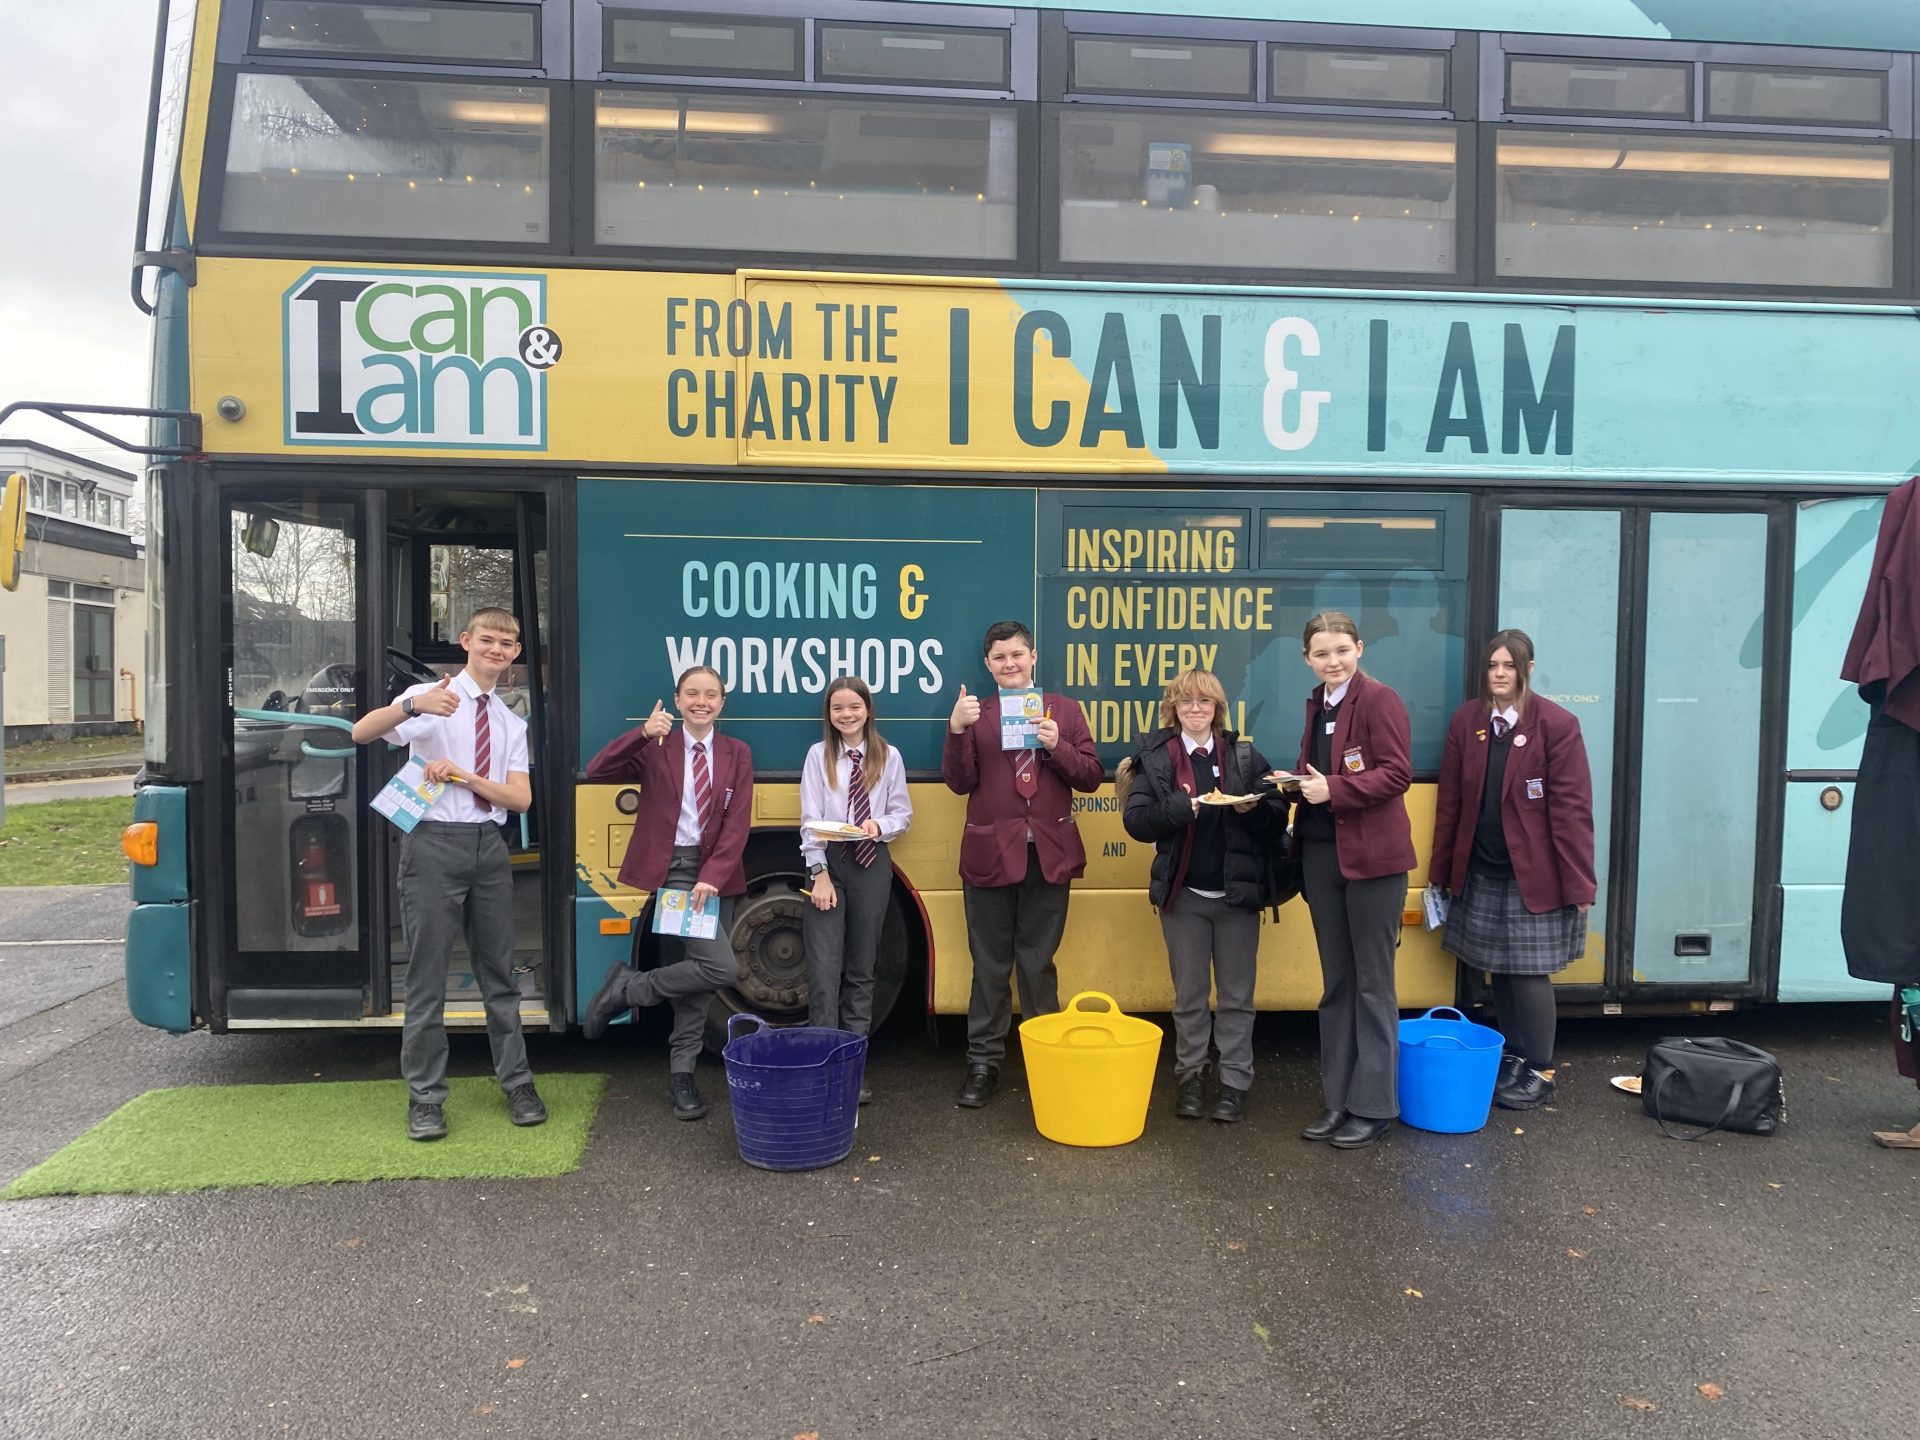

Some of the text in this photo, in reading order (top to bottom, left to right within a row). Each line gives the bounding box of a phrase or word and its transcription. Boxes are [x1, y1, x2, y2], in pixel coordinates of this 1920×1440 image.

[295, 279, 378, 434] I
[355, 282, 533, 366] can
[667, 297, 898, 364] FROM THE
[355, 352, 534, 436] am
[667, 368, 898, 444] CHARITY
[949, 308, 1576, 455] I CAN & I AM
[1067, 528, 1236, 573] INSPIRING
[682, 560, 929, 621] COOKING &
[1067, 586, 1273, 630] CONFIDENCE
[665, 636, 944, 694] WORKSHOPS
[1066, 643, 1098, 687] IN
[1573, 694, 1600, 703] ONLY
[1103, 842, 1127, 857] AND
